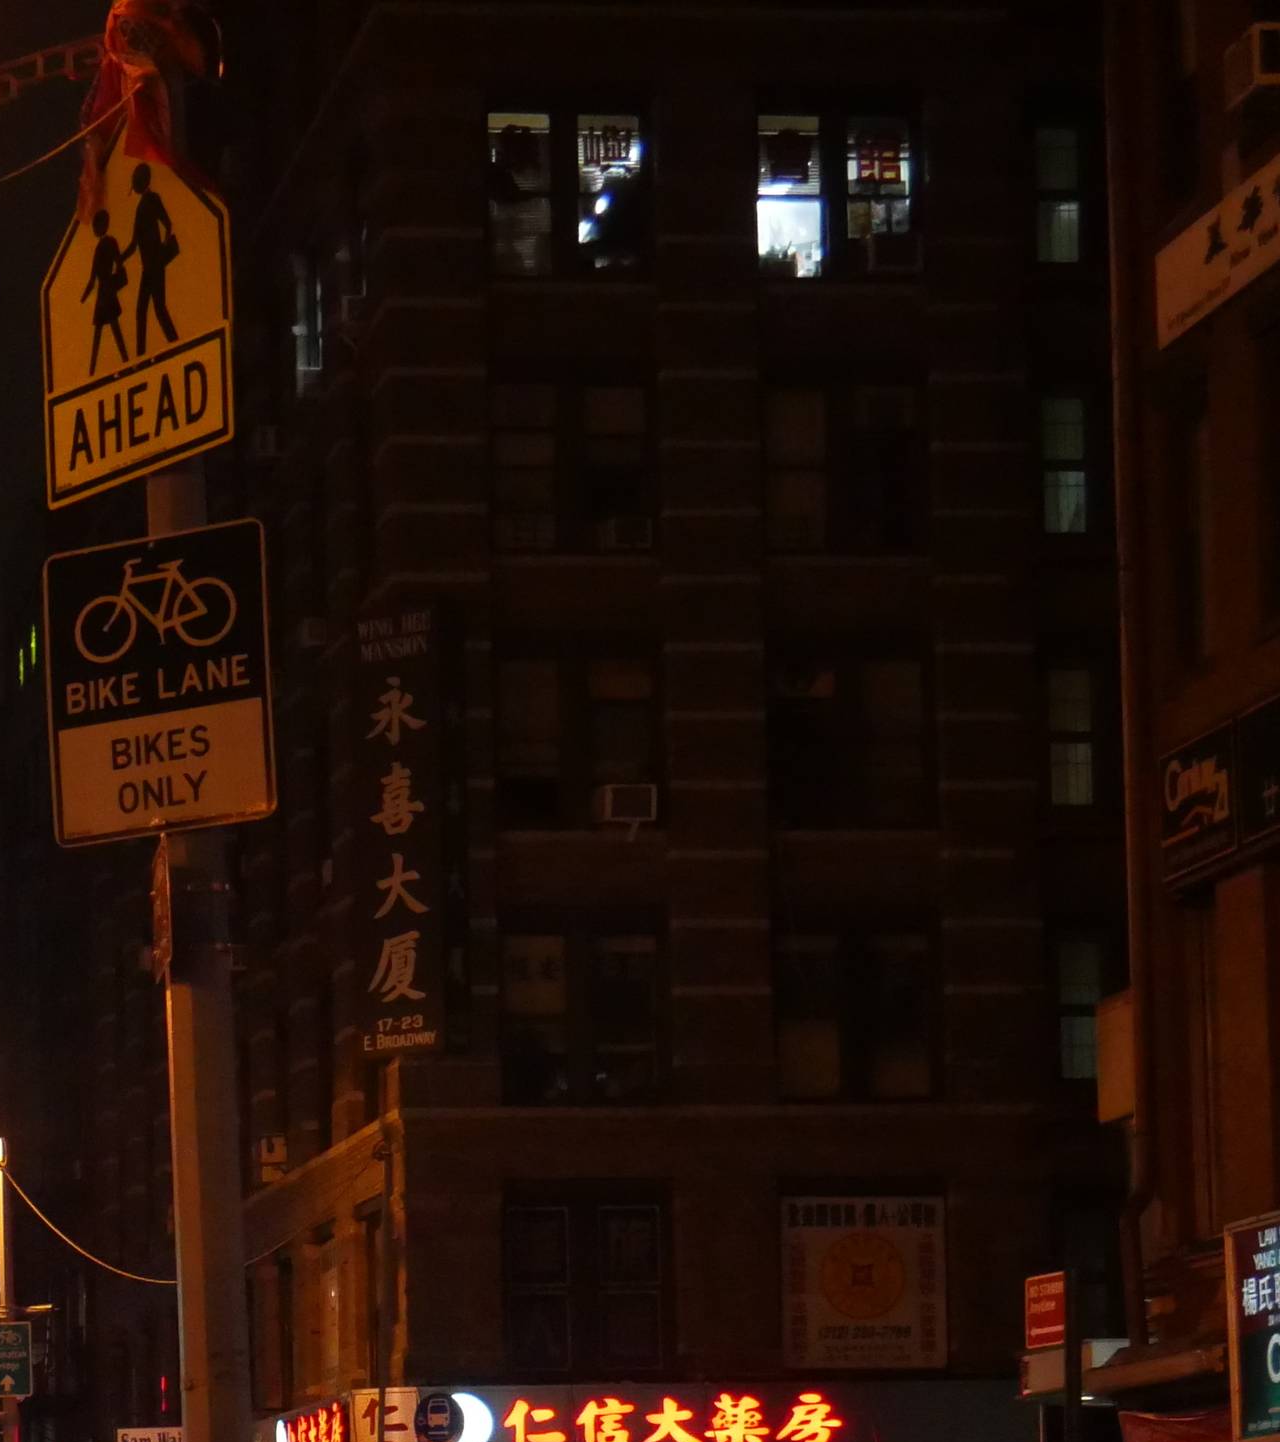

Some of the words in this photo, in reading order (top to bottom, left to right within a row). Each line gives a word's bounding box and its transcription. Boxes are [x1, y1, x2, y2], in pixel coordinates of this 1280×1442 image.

[69, 360, 208, 471] AHEAD
[65, 671, 141, 715] BIKE
[157, 653, 251, 700] LANE
[111, 724, 210, 770] BIKES
[118, 771, 208, 813] ONLY
[376, 1013, 424, 1031] 17-23
